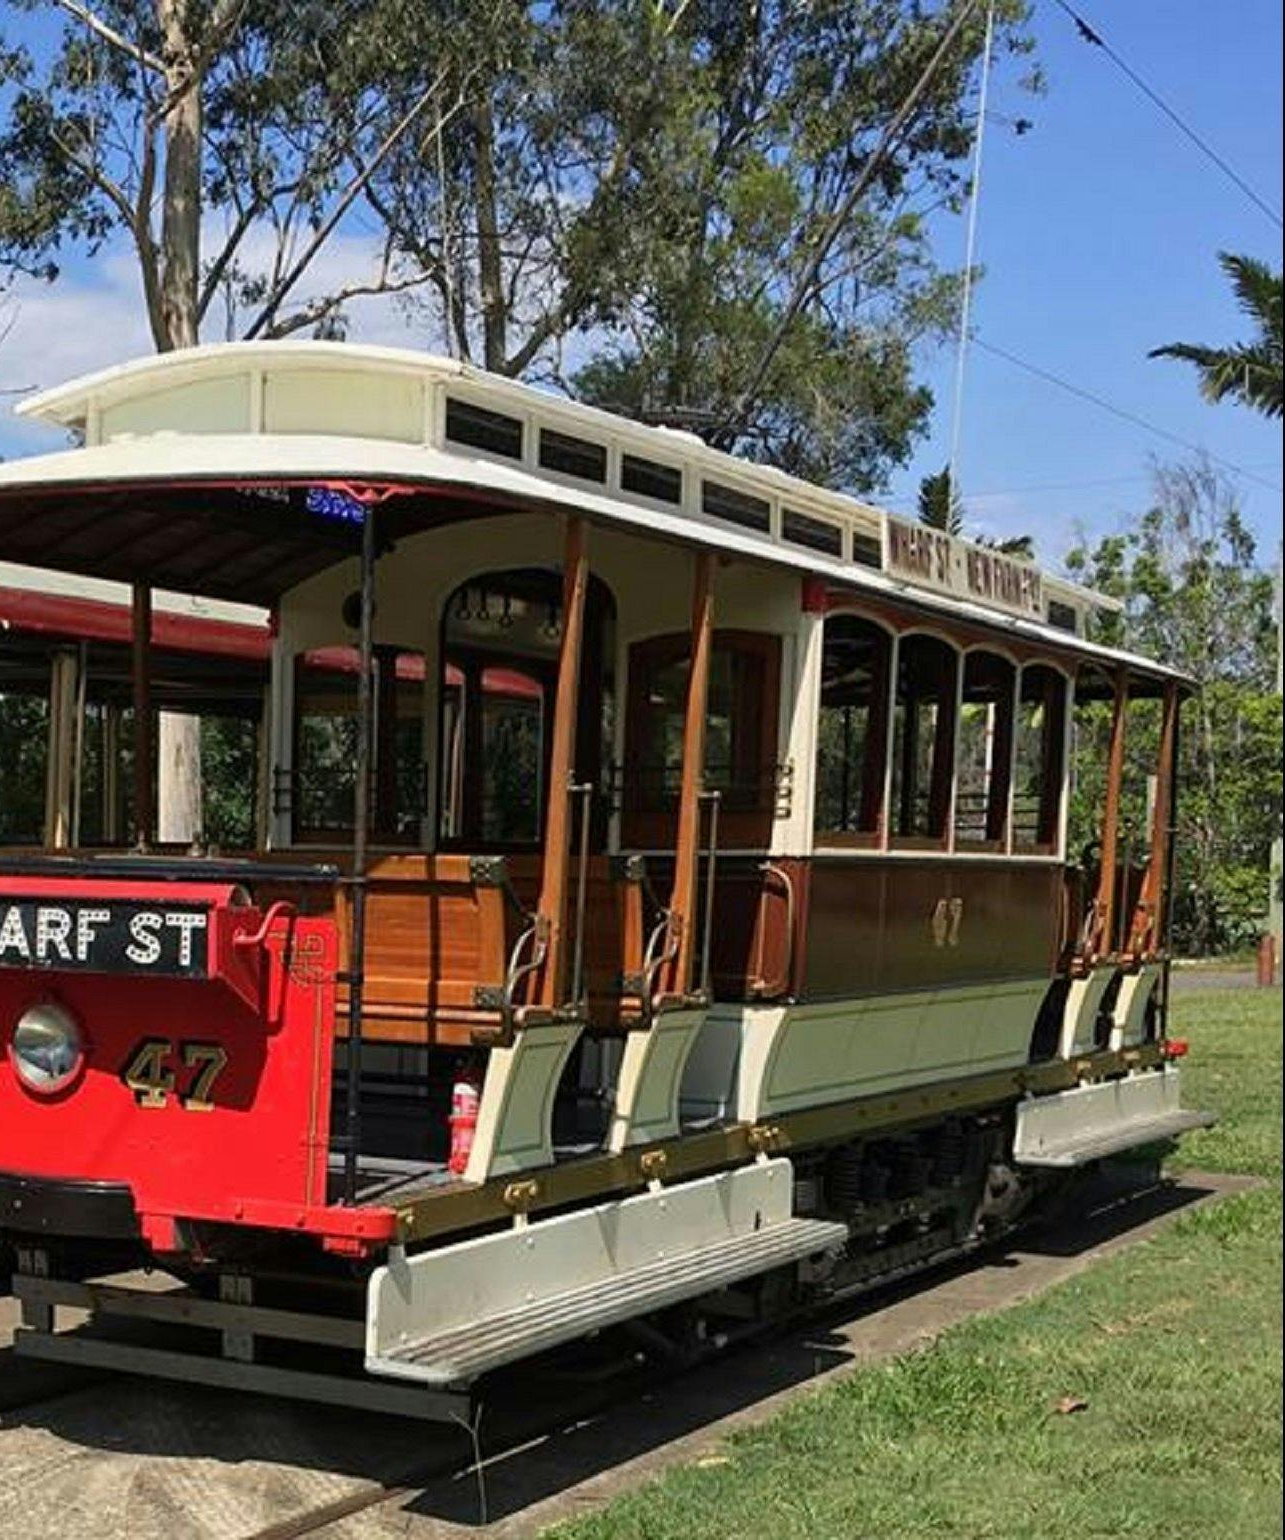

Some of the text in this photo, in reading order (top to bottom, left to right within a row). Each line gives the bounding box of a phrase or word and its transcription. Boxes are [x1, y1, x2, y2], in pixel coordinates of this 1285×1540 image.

[125, 911, 207, 967] ST
[932, 897, 963, 947] 47
[125, 1039, 228, 1112] 47
